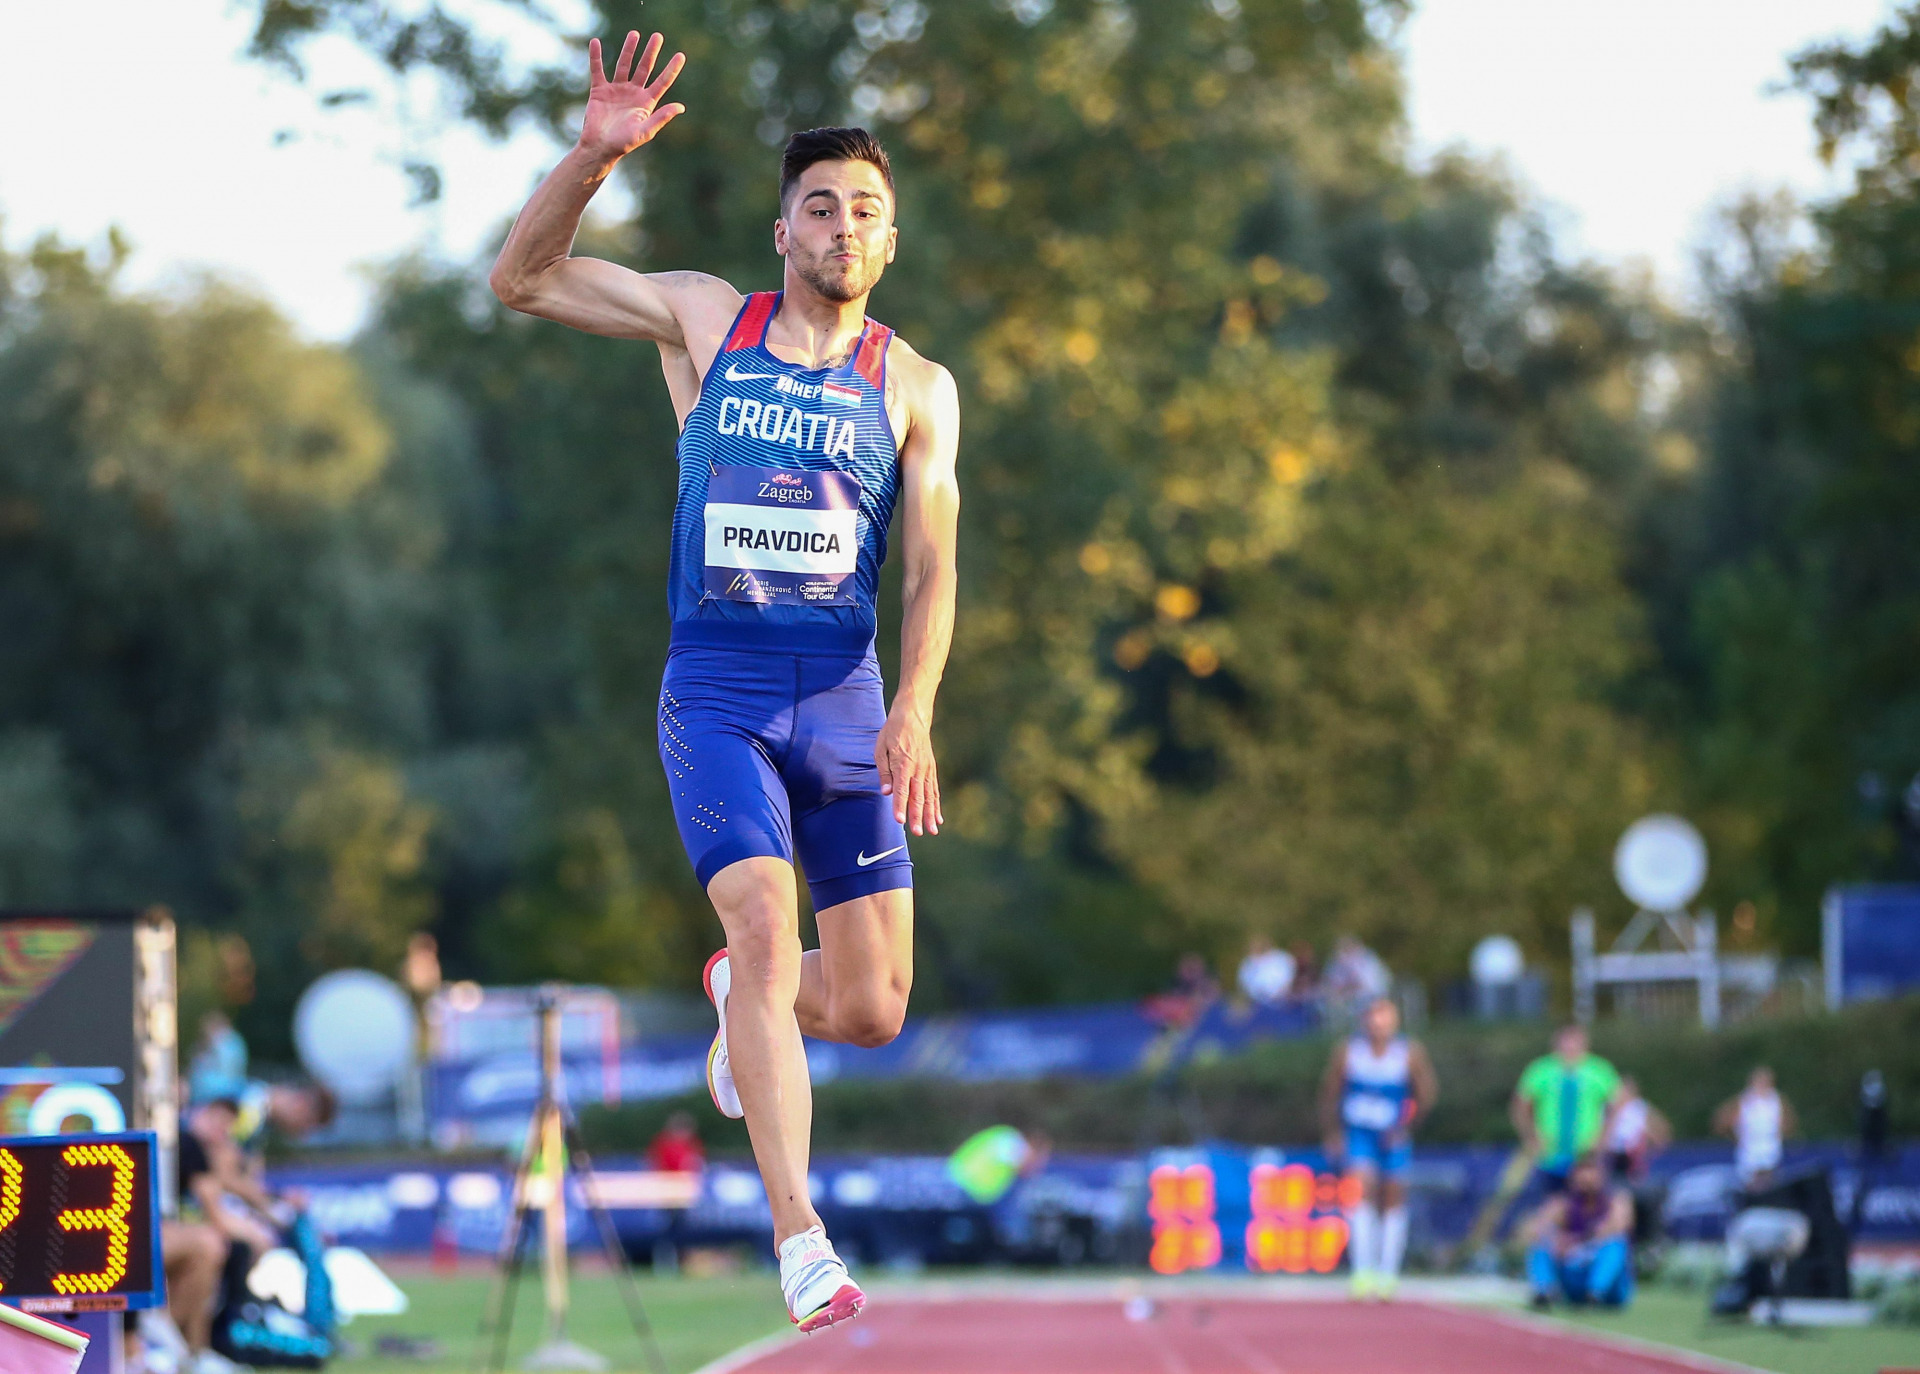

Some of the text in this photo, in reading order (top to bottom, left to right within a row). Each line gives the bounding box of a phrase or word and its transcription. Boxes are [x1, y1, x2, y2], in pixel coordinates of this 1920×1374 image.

[791, 380, 823, 399] HEP
[718, 396, 856, 461] CROATIA
[757, 482, 813, 503] Zagreb
[724, 526, 841, 554] PRAVDICA
[799, 585, 839, 594] Continental
[803, 592, 818, 600] Tour
